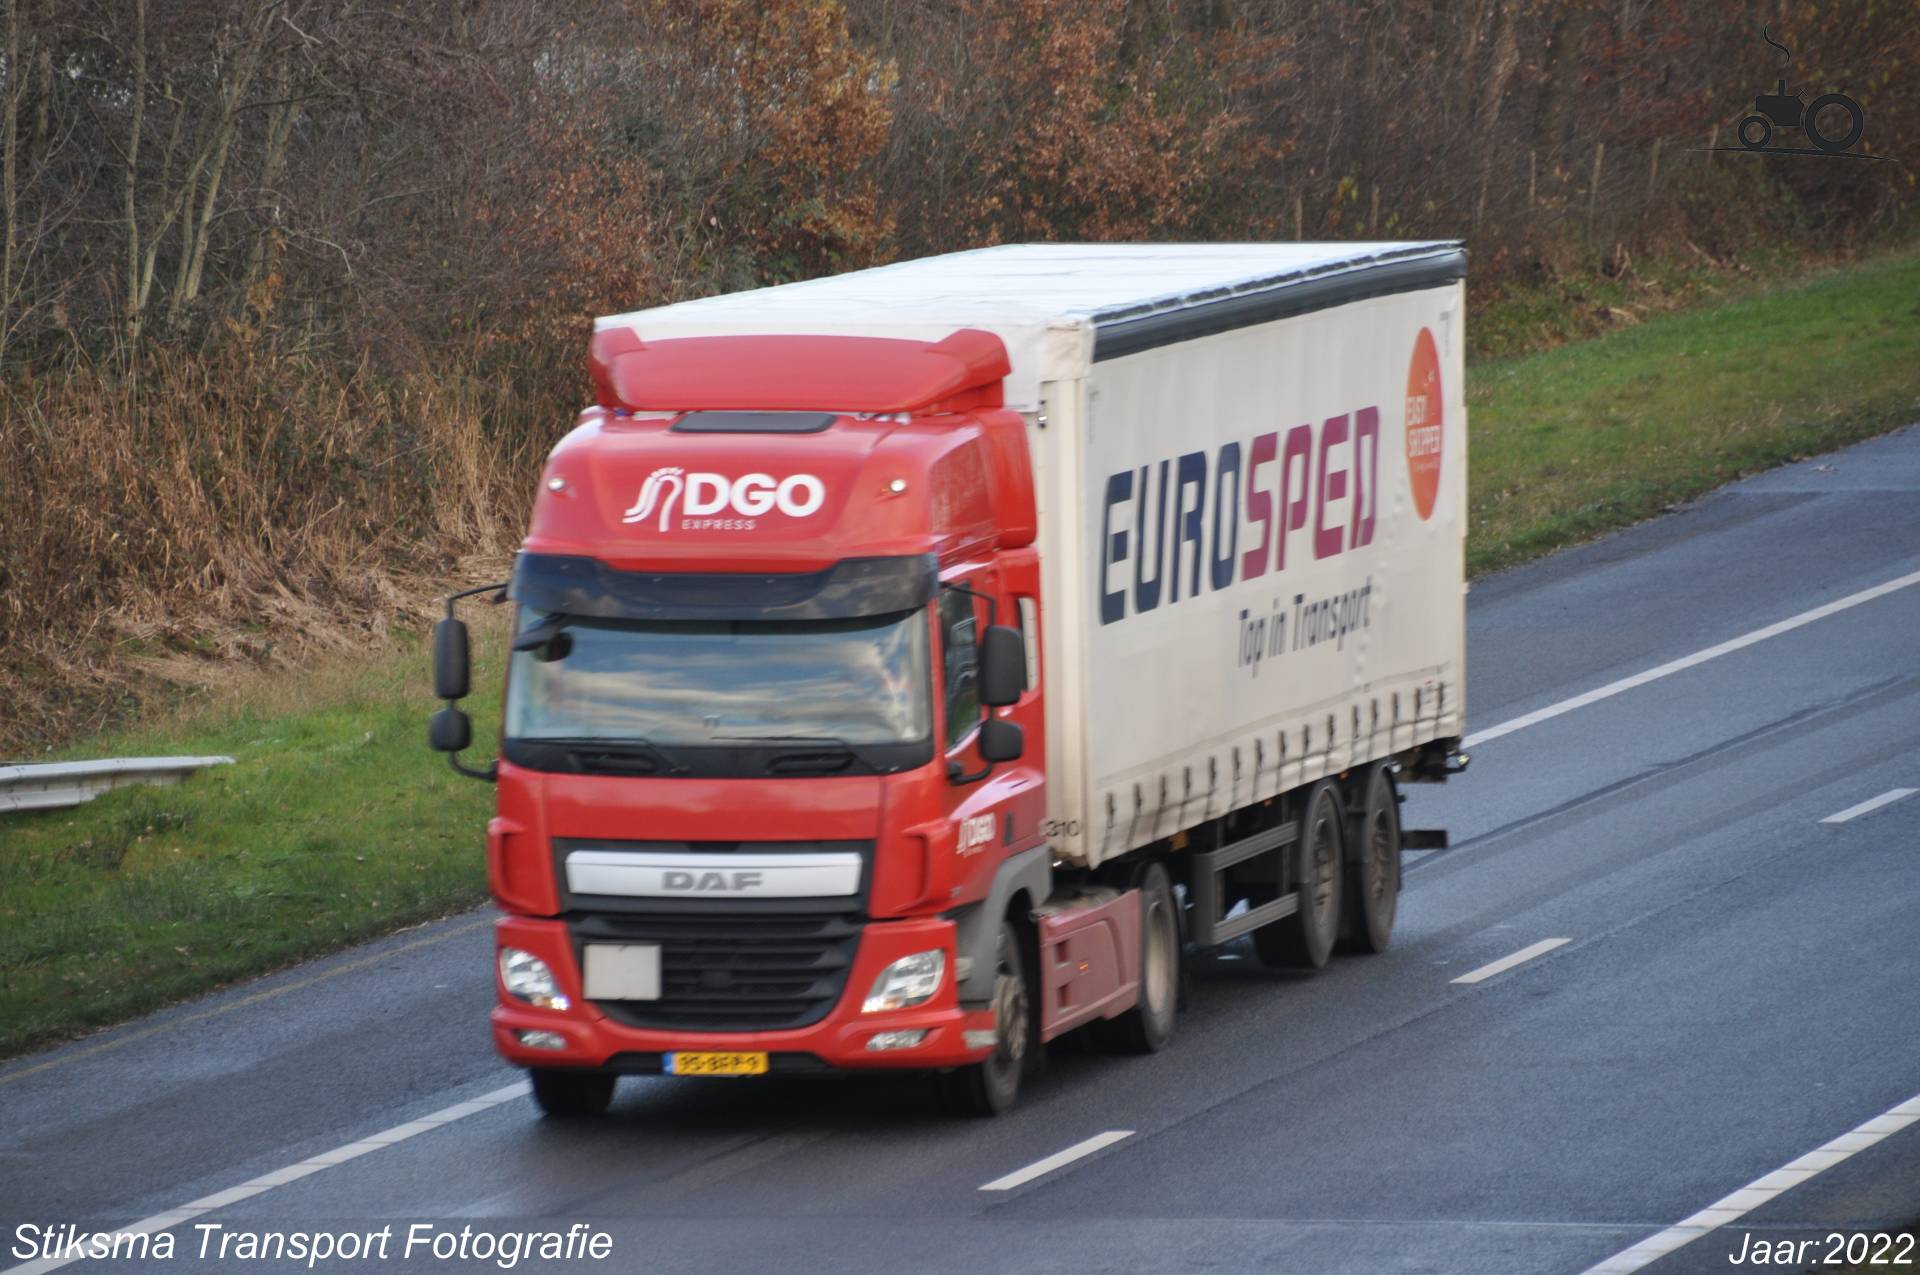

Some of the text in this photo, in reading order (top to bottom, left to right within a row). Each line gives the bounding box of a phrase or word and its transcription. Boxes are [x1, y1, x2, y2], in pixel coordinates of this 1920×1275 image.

[681, 518, 756, 530] EXPRESS
[1099, 405, 1379, 626] EUROSPED
[1237, 576, 1373, 678] Top in Transport
[661, 871, 763, 891] DAF
